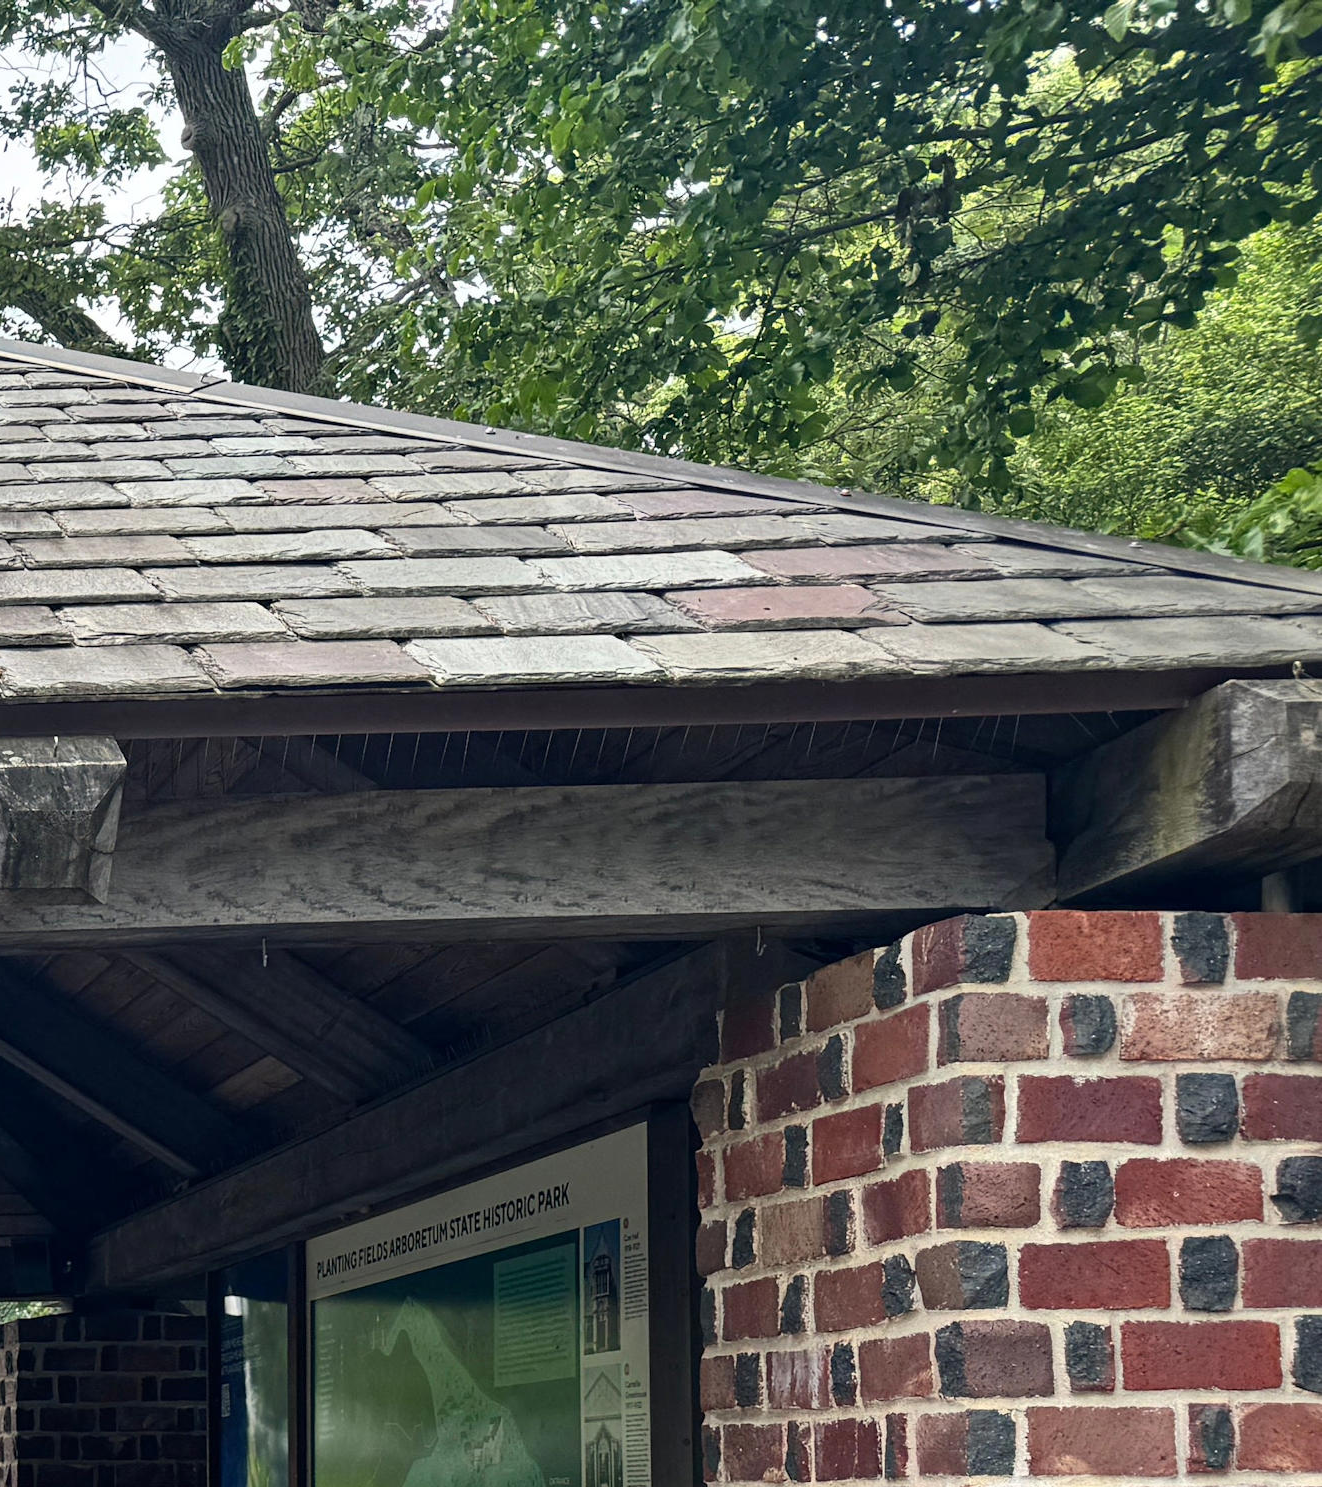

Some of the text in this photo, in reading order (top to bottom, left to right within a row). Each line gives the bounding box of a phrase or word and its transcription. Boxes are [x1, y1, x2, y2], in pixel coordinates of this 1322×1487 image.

[316, 1182, 570, 1279] PLANTING FIELDS ARBORETUM STATE HISTORIC PARK
